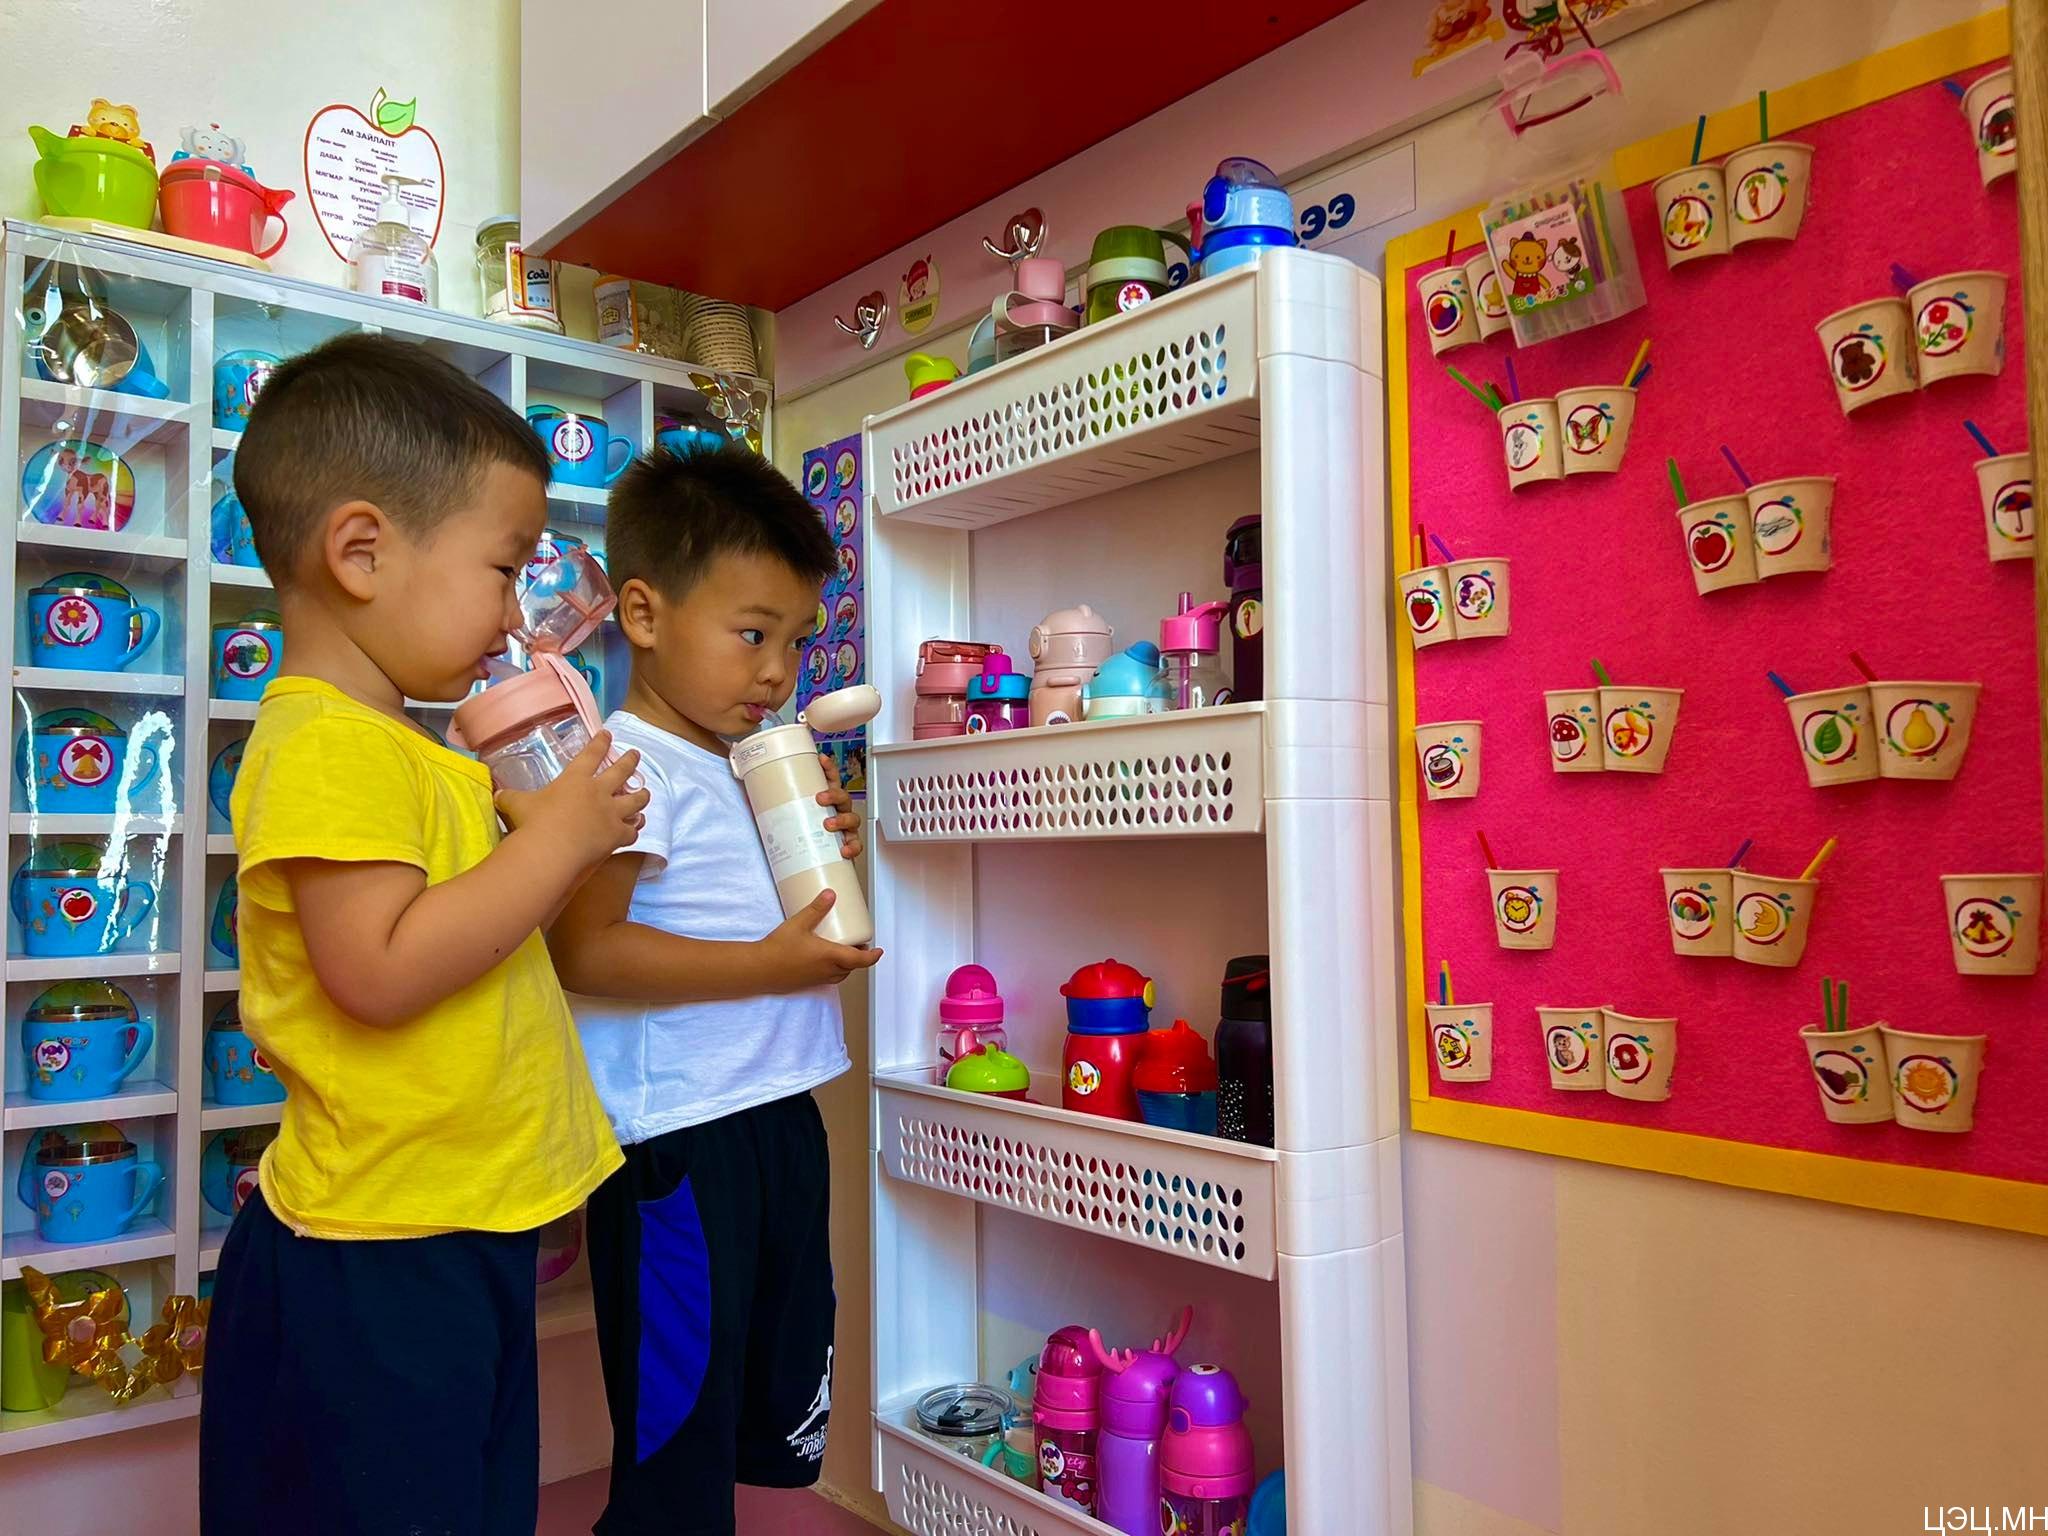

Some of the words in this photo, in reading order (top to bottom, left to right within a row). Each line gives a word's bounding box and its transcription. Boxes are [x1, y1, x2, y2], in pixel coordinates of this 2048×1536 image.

[341, 127, 354, 137] АМ
[355, 130, 396, 148] ЗАЙЛАЛТ
[330, 232, 354, 243] БААСА
[796, 1434, 825, 1457] JORD
